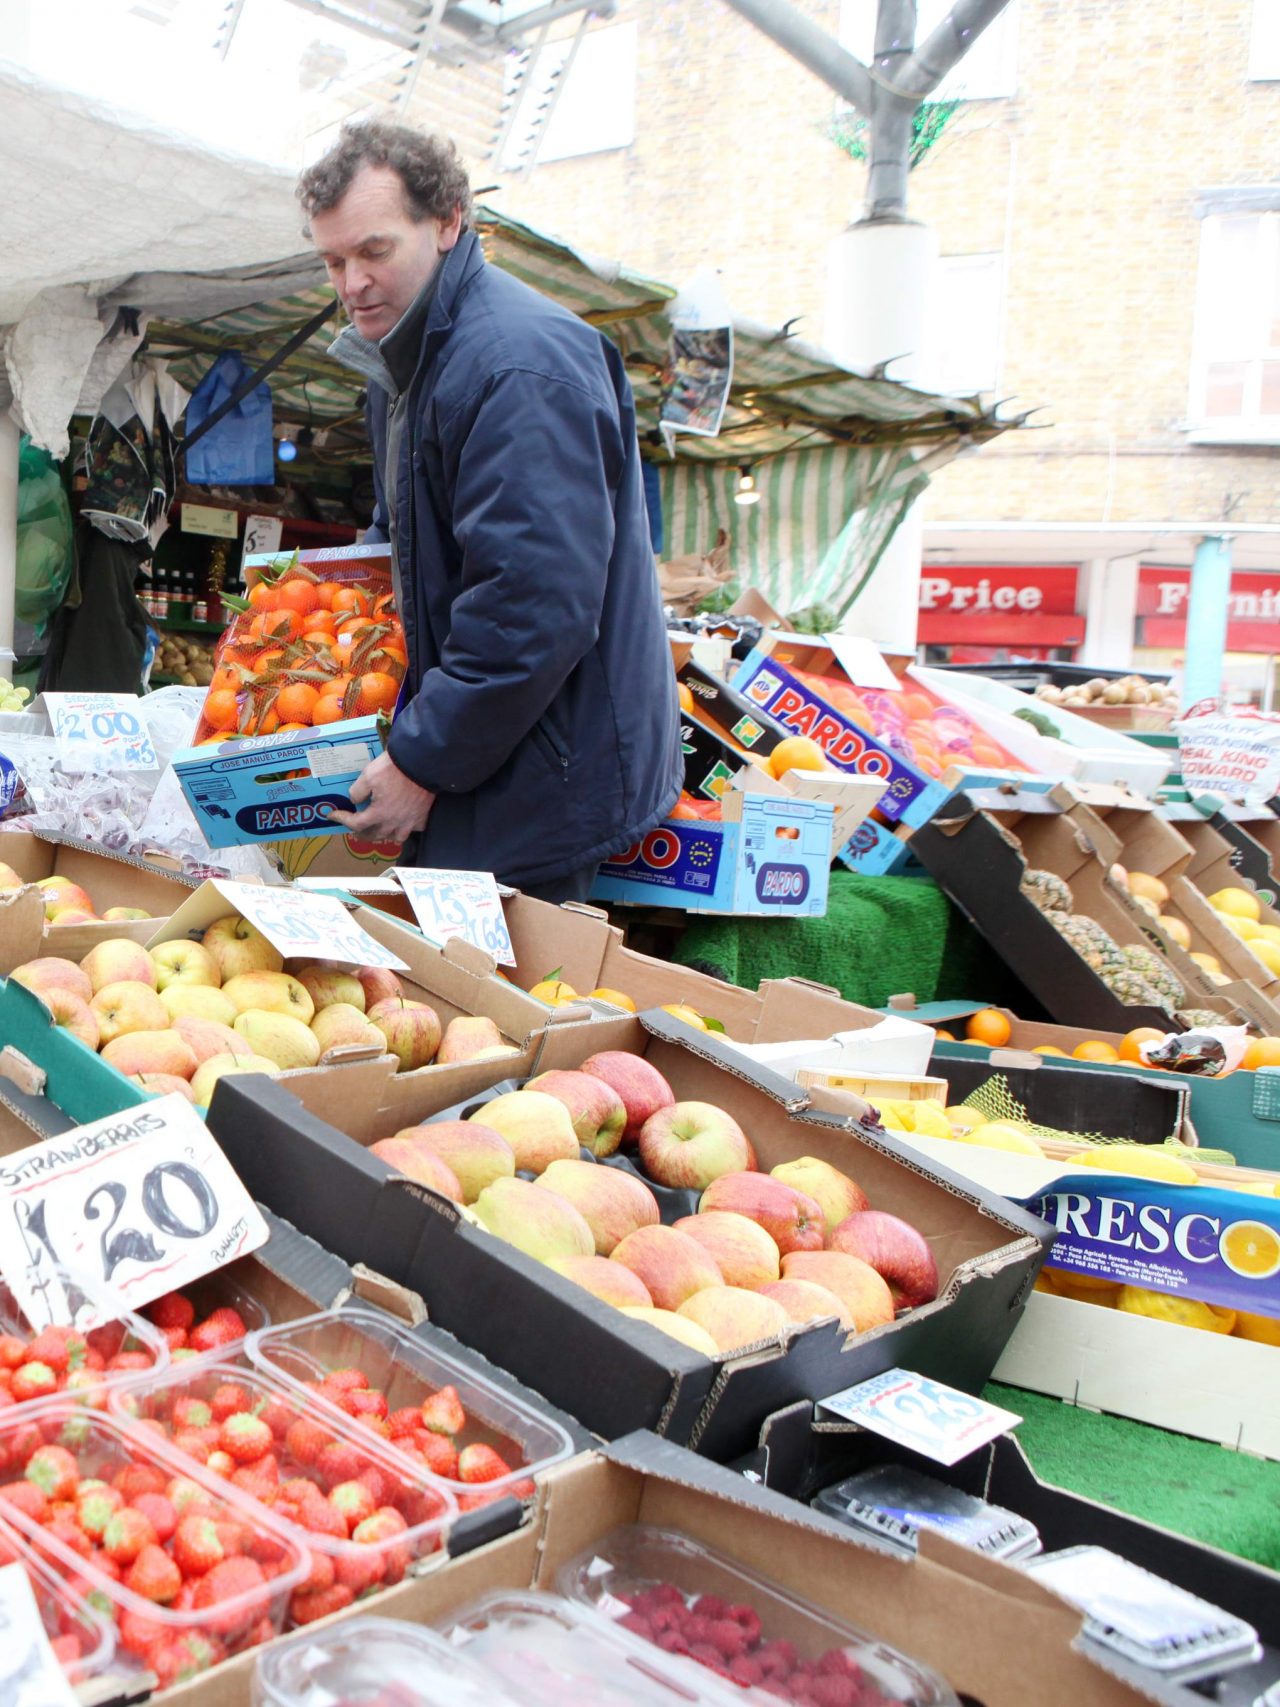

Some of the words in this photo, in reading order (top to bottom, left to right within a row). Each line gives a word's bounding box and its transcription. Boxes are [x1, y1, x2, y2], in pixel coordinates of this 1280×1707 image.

[919, 577, 1044, 610] Price
[769, 686, 893, 783] PARDO
[220, 760, 241, 770] JOSE
[242, 753, 274, 765] MANUEL
[276, 748, 305, 759] PARDO
[1221, 750, 1270, 770] KING
[255, 801, 340, 831] PARDO
[761, 870, 804, 898] PARDO
